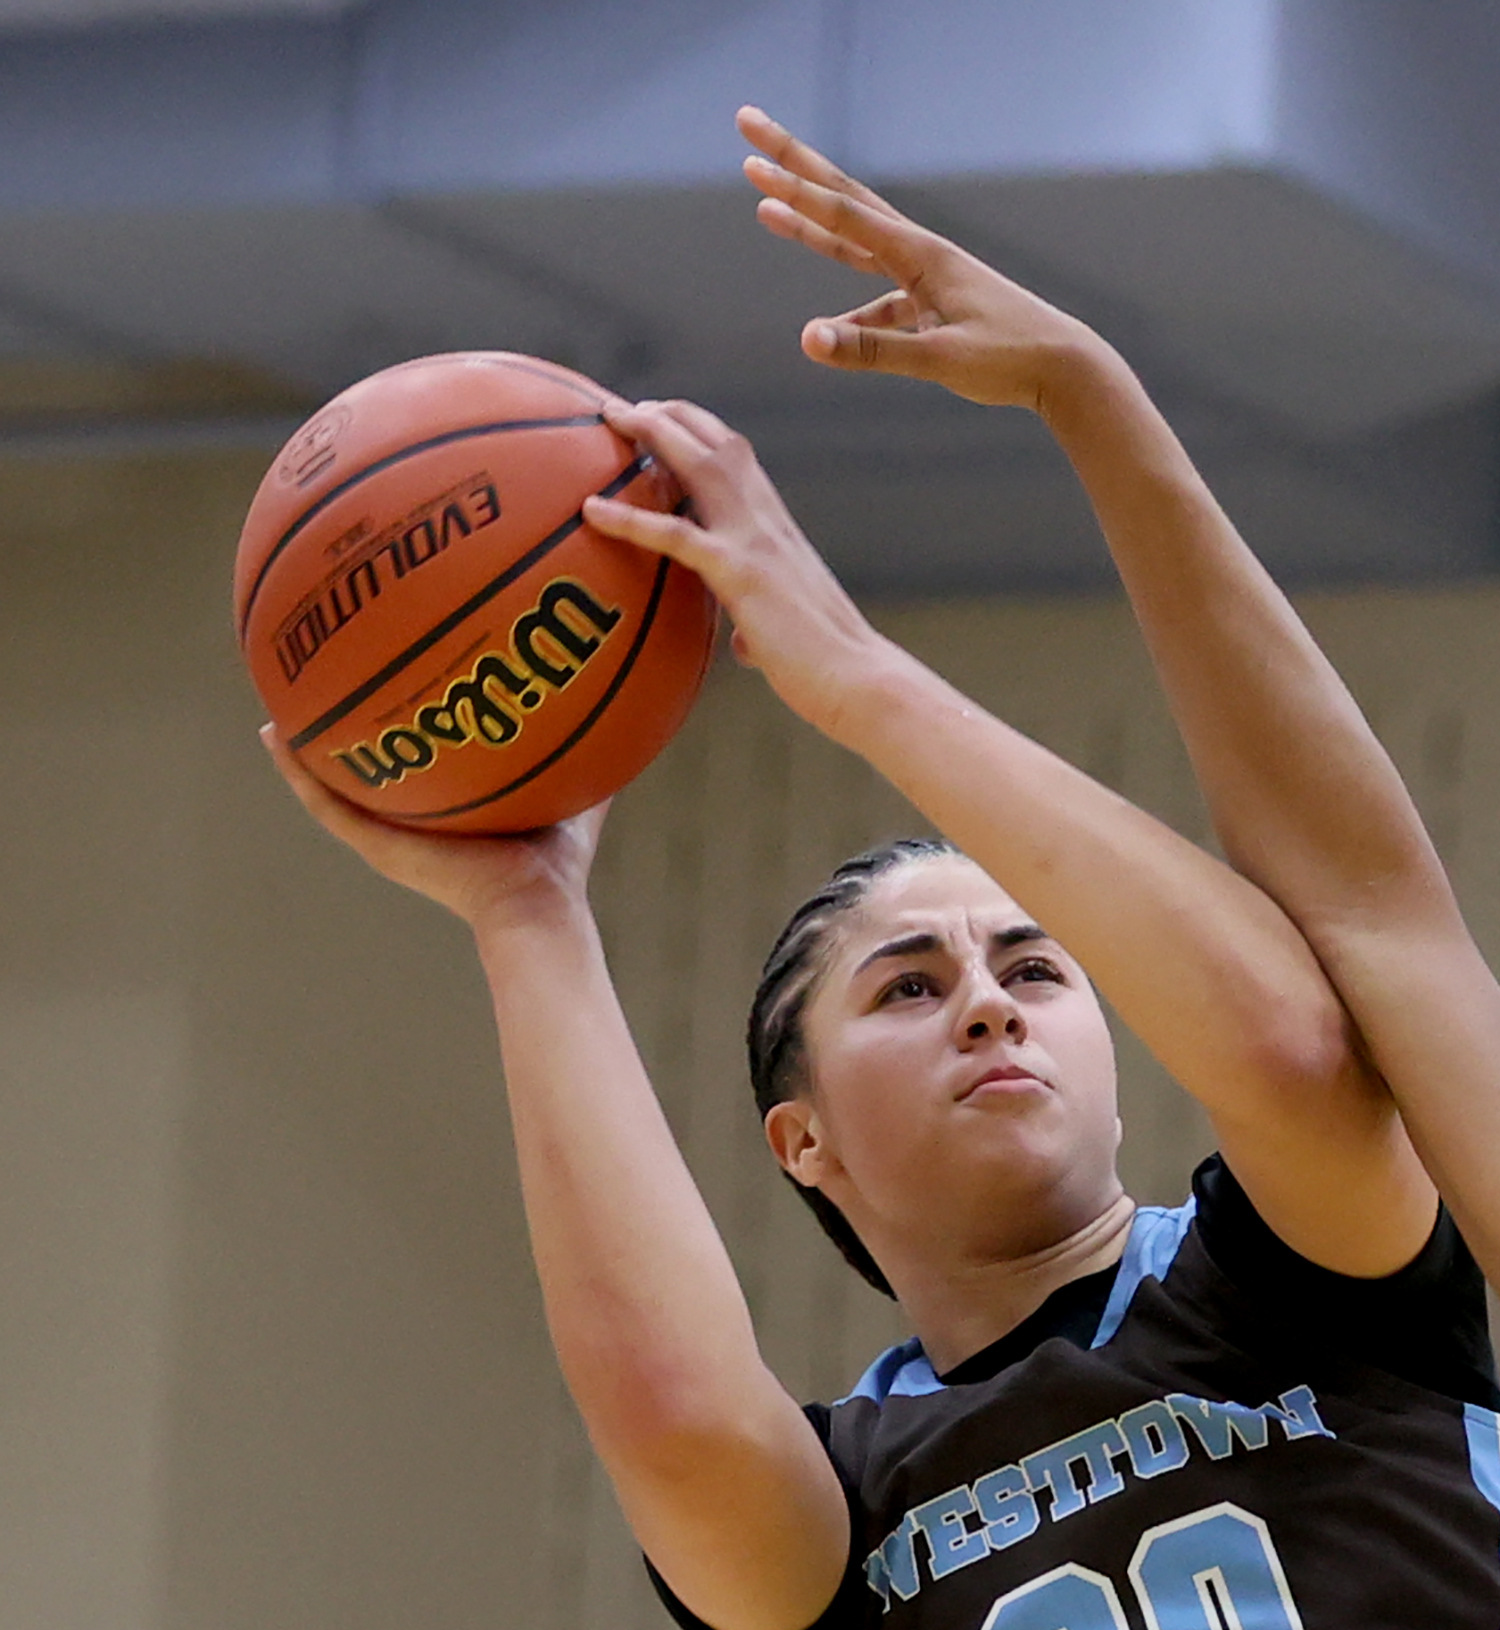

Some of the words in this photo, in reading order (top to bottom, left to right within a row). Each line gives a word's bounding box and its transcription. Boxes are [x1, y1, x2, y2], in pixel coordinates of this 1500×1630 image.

[274, 482, 502, 684] EVOLUTION
[329, 575, 624, 789] Wilson
[862, 1384, 1337, 1614] WESTTOWN
